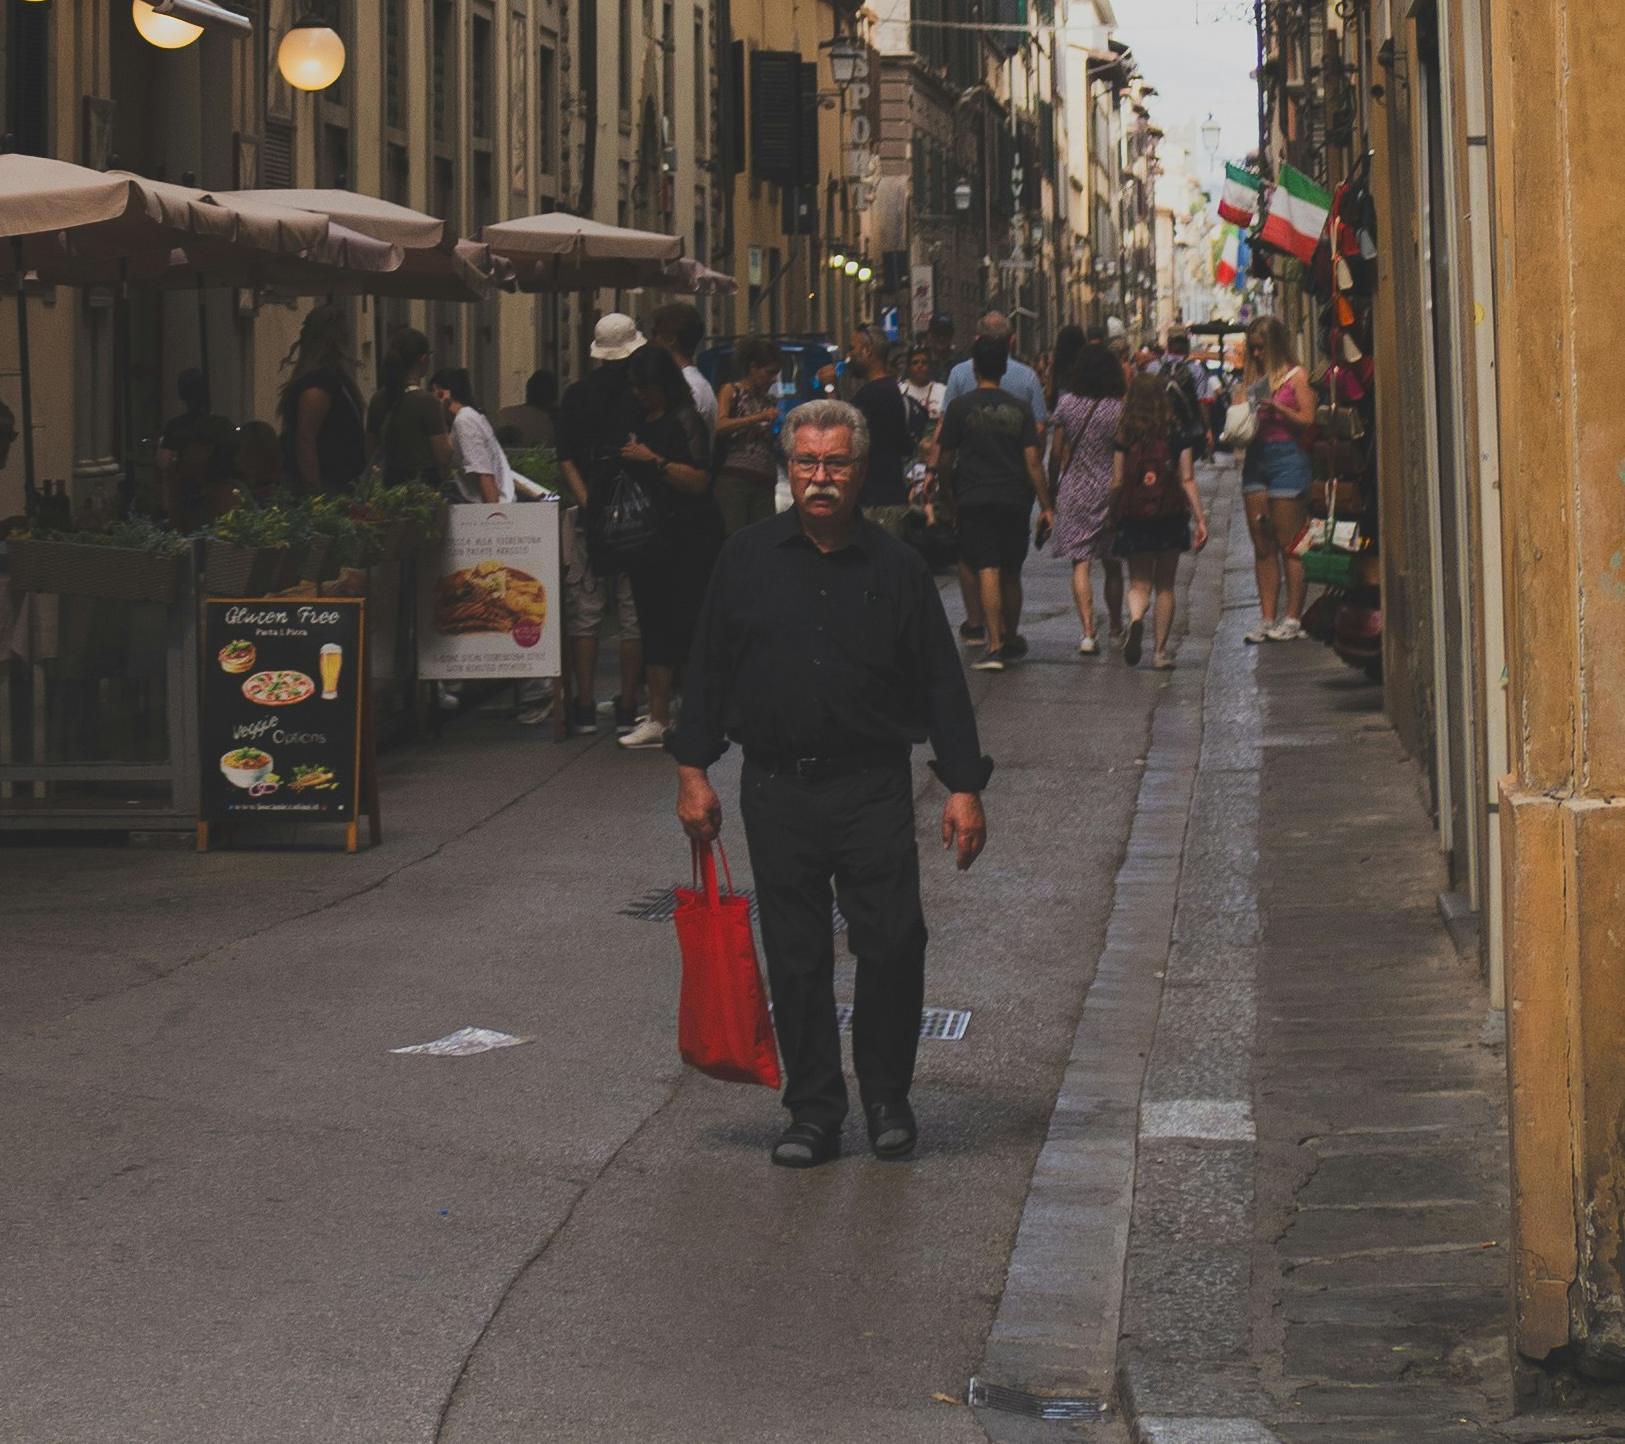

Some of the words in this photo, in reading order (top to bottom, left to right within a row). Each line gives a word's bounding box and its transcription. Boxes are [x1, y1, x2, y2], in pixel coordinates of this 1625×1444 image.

[225, 606, 289, 625] Gluten
[297, 605, 340, 625] Free
[232, 715, 279, 740] Veggie
